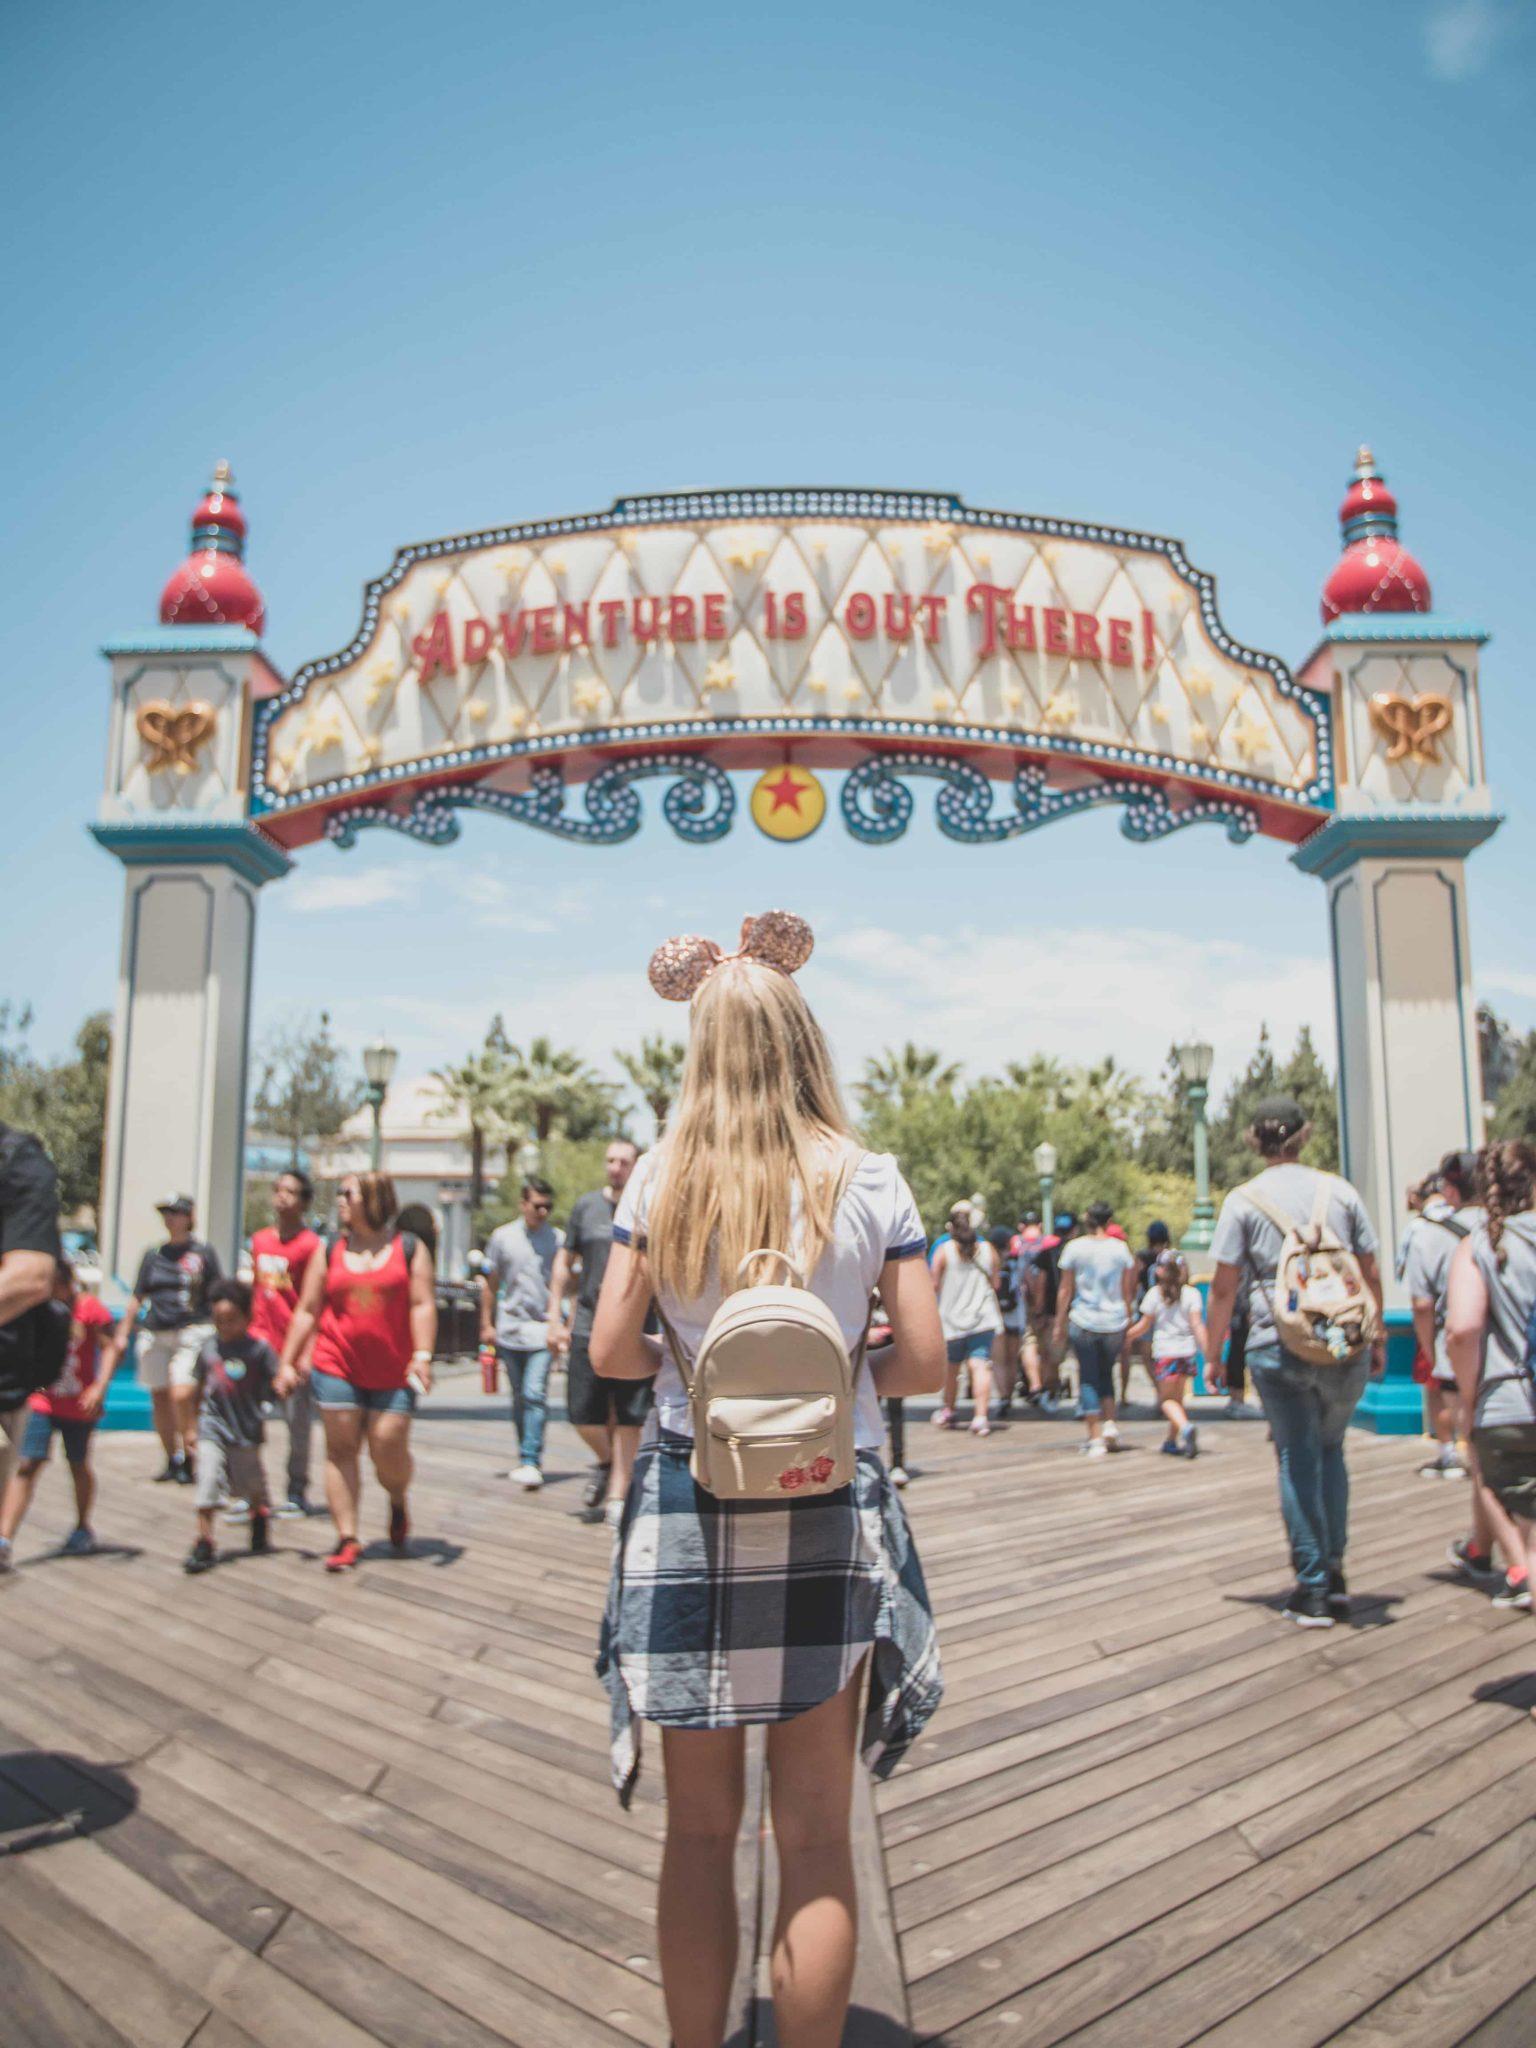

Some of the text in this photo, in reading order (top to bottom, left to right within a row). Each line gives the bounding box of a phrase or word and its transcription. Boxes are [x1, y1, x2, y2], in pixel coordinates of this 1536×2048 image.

[411, 582, 1157, 686] ADVENTURE IS OUT THERE!
